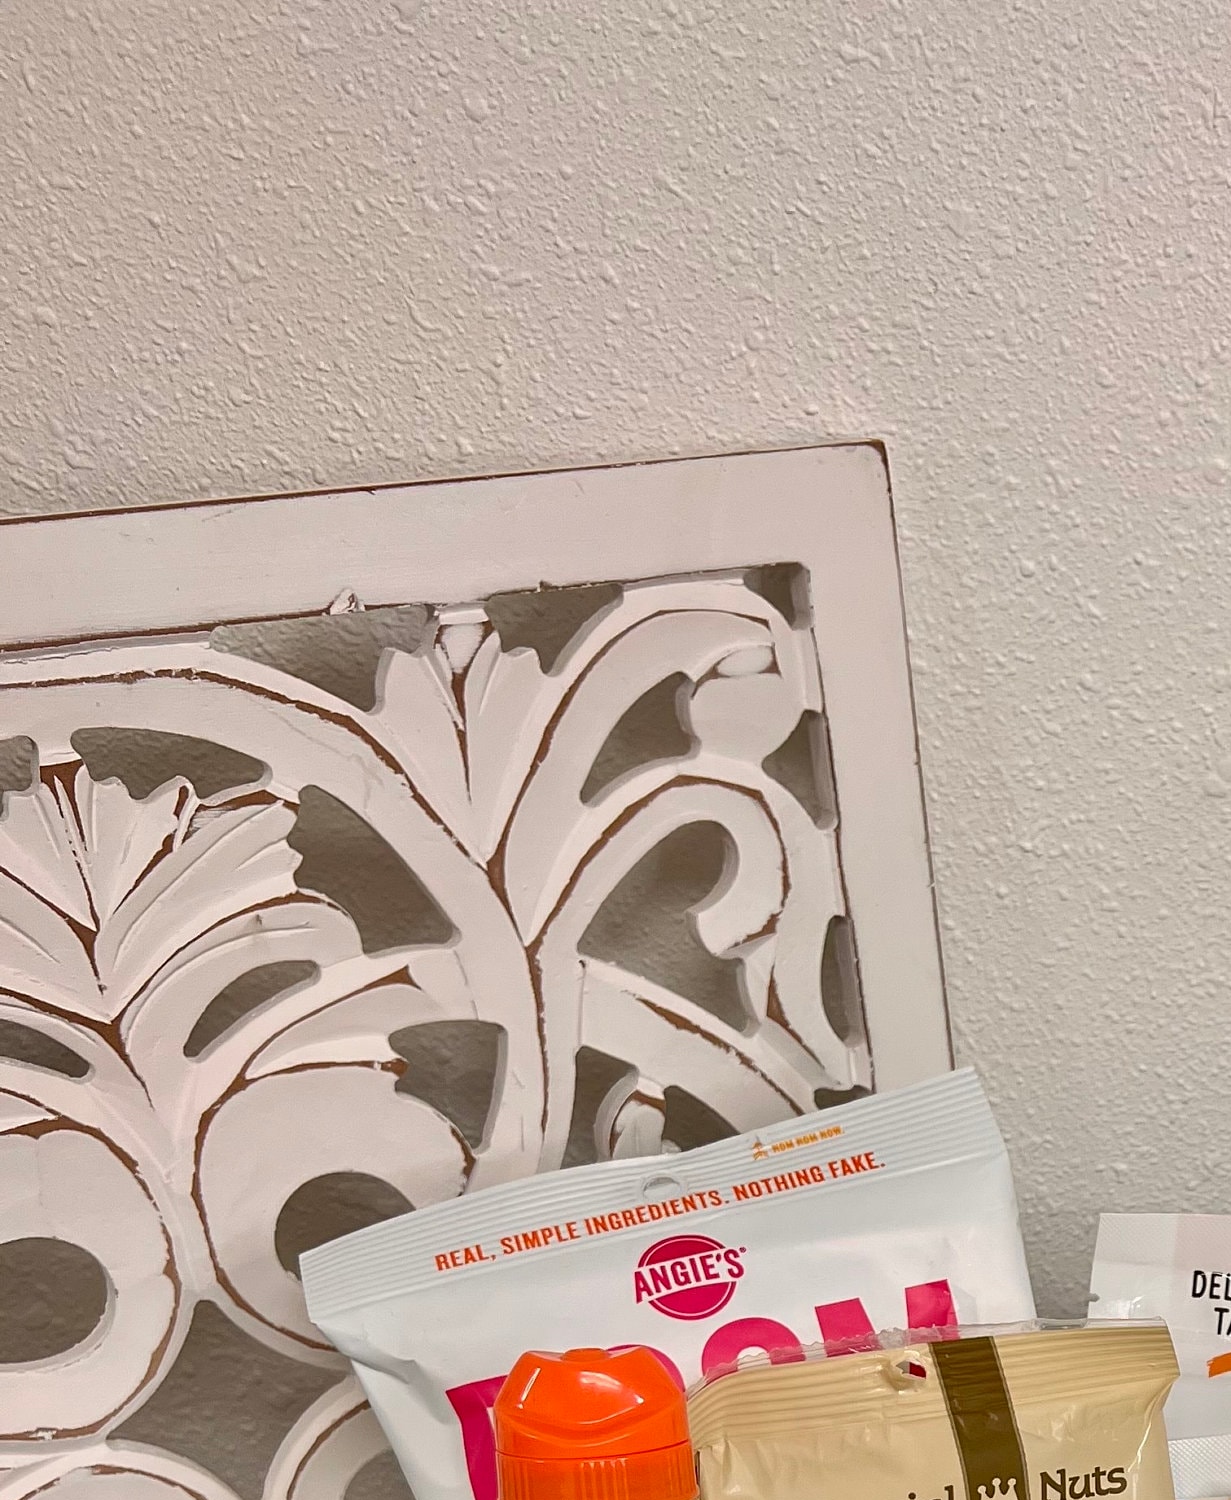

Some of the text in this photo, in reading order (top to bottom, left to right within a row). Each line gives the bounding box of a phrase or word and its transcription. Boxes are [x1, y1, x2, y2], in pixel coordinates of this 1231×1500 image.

[434, 1151, 886, 1271] REAL, SIMPLE INGREDIENTS. NOTHING FAKE.
[634, 1248, 745, 1304] ANGIE'S
